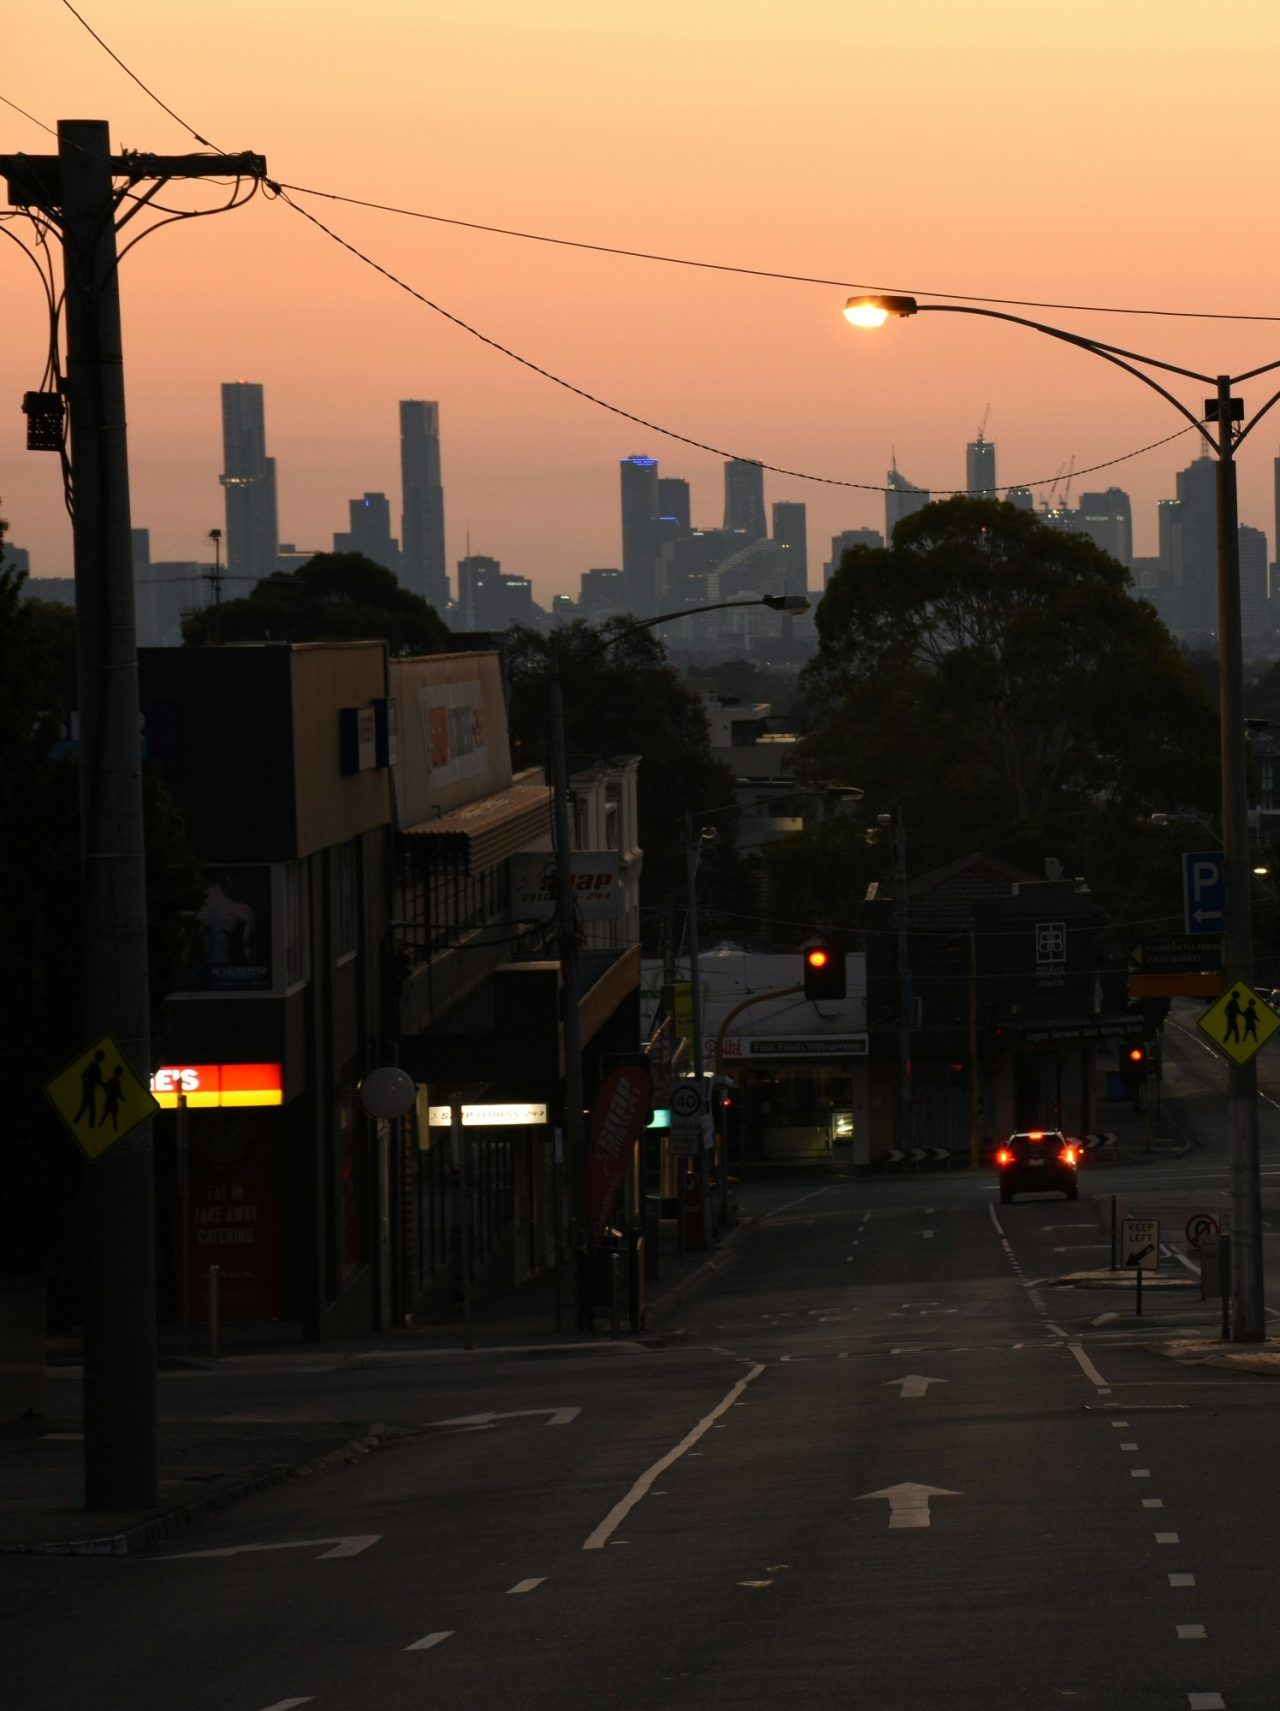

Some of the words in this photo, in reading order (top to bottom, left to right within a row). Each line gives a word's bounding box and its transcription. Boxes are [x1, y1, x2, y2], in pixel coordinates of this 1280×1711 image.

[1193, 862, 1219, 902] P
[212, 966, 266, 977] KIESER
[150, 1069, 200, 1092] E'S
[676, 1094, 695, 1108] 40
[207, 1183, 227, 1201] EAT
[231, 1183, 245, 1201] IN
[193, 1206, 223, 1223] TAKE
[225, 1205, 259, 1222] AWAY
[197, 1227, 256, 1245] CATERING
[1129, 1223, 1154, 1232] KEEP
[1129, 1234, 1152, 1242] LEFT
